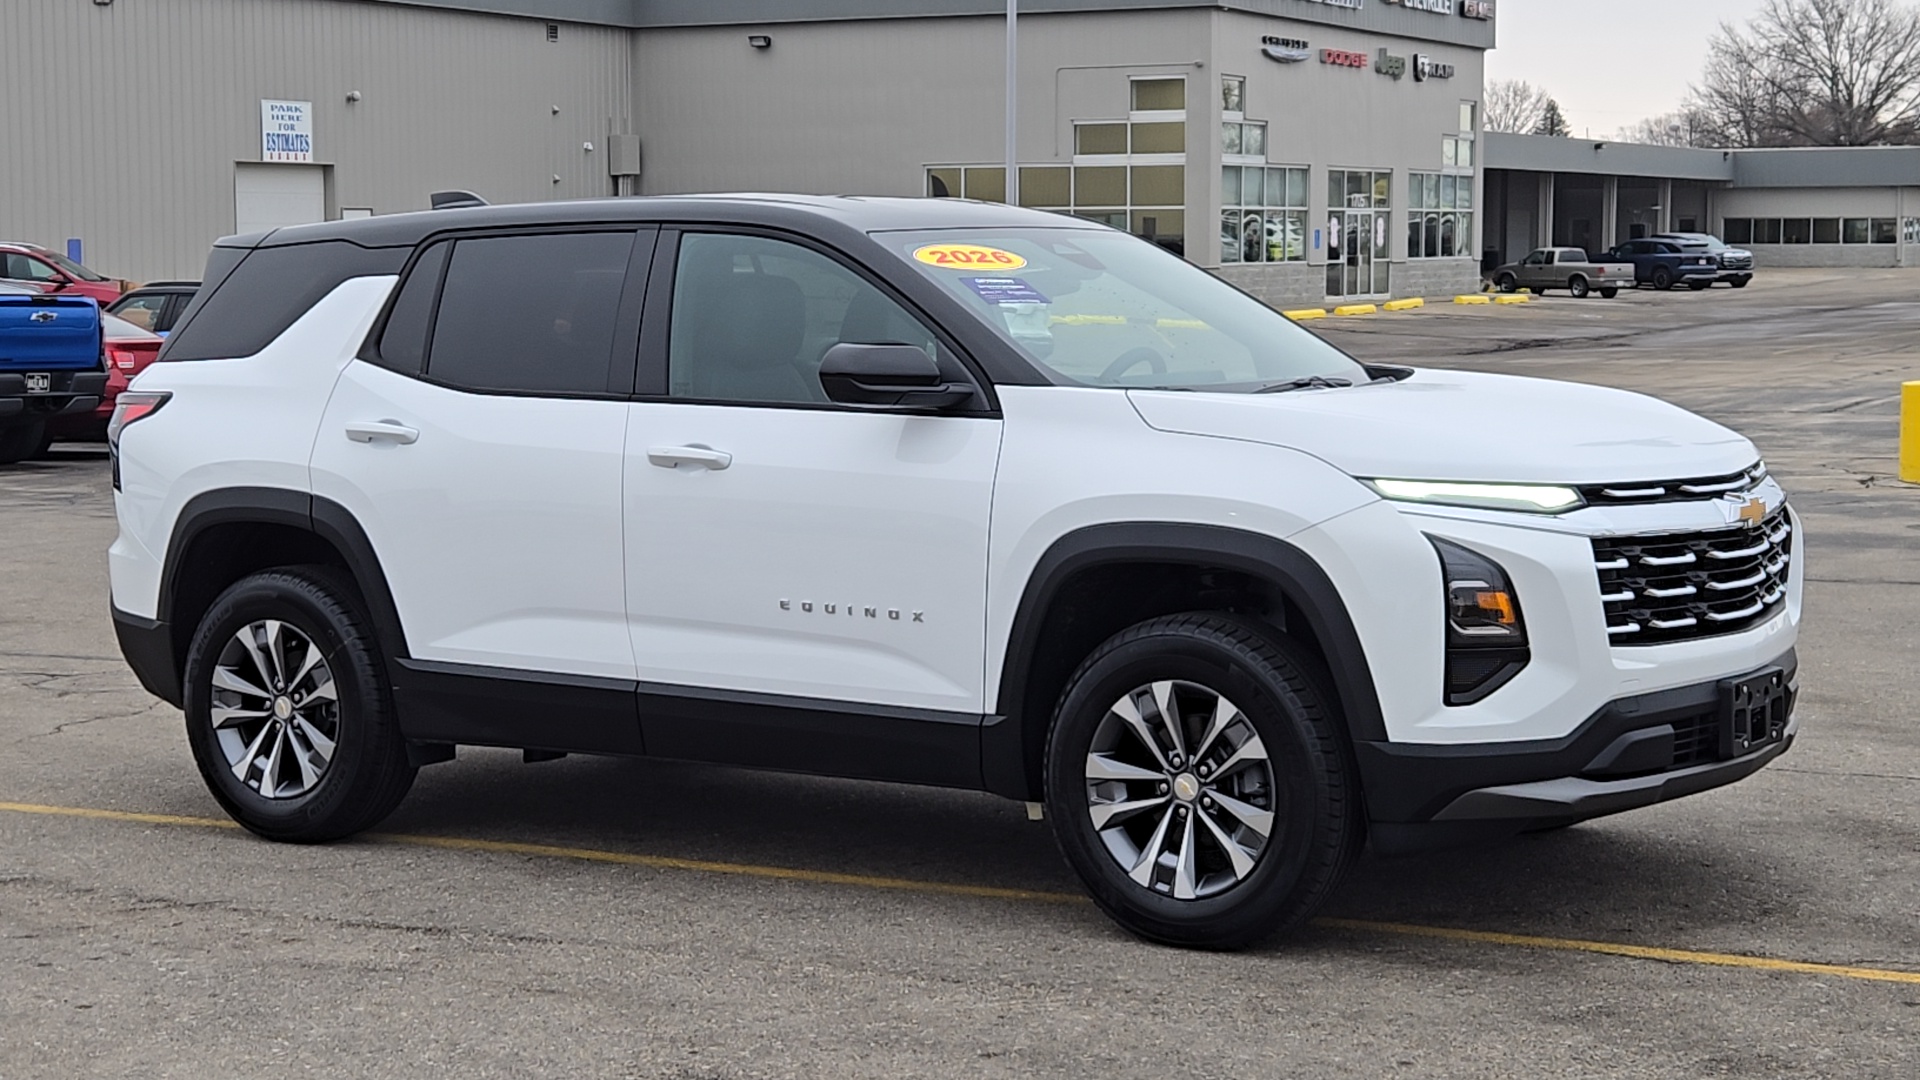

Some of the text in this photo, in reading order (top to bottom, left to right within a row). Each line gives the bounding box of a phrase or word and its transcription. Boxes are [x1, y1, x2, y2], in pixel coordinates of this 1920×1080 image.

[1323, 49, 1367, 67] DODGE
[1375, 48, 1406, 81] Jeep
[1428, 62, 1455, 79] RAM
[270, 104, 303, 113] PARK
[271, 113, 303, 122] HERE
[278, 122, 296, 131] FOR
[266, 132, 310, 153] ESTIMATES
[929, 250, 1013, 263] 2026
[779, 599, 925, 623] EQUINOX
